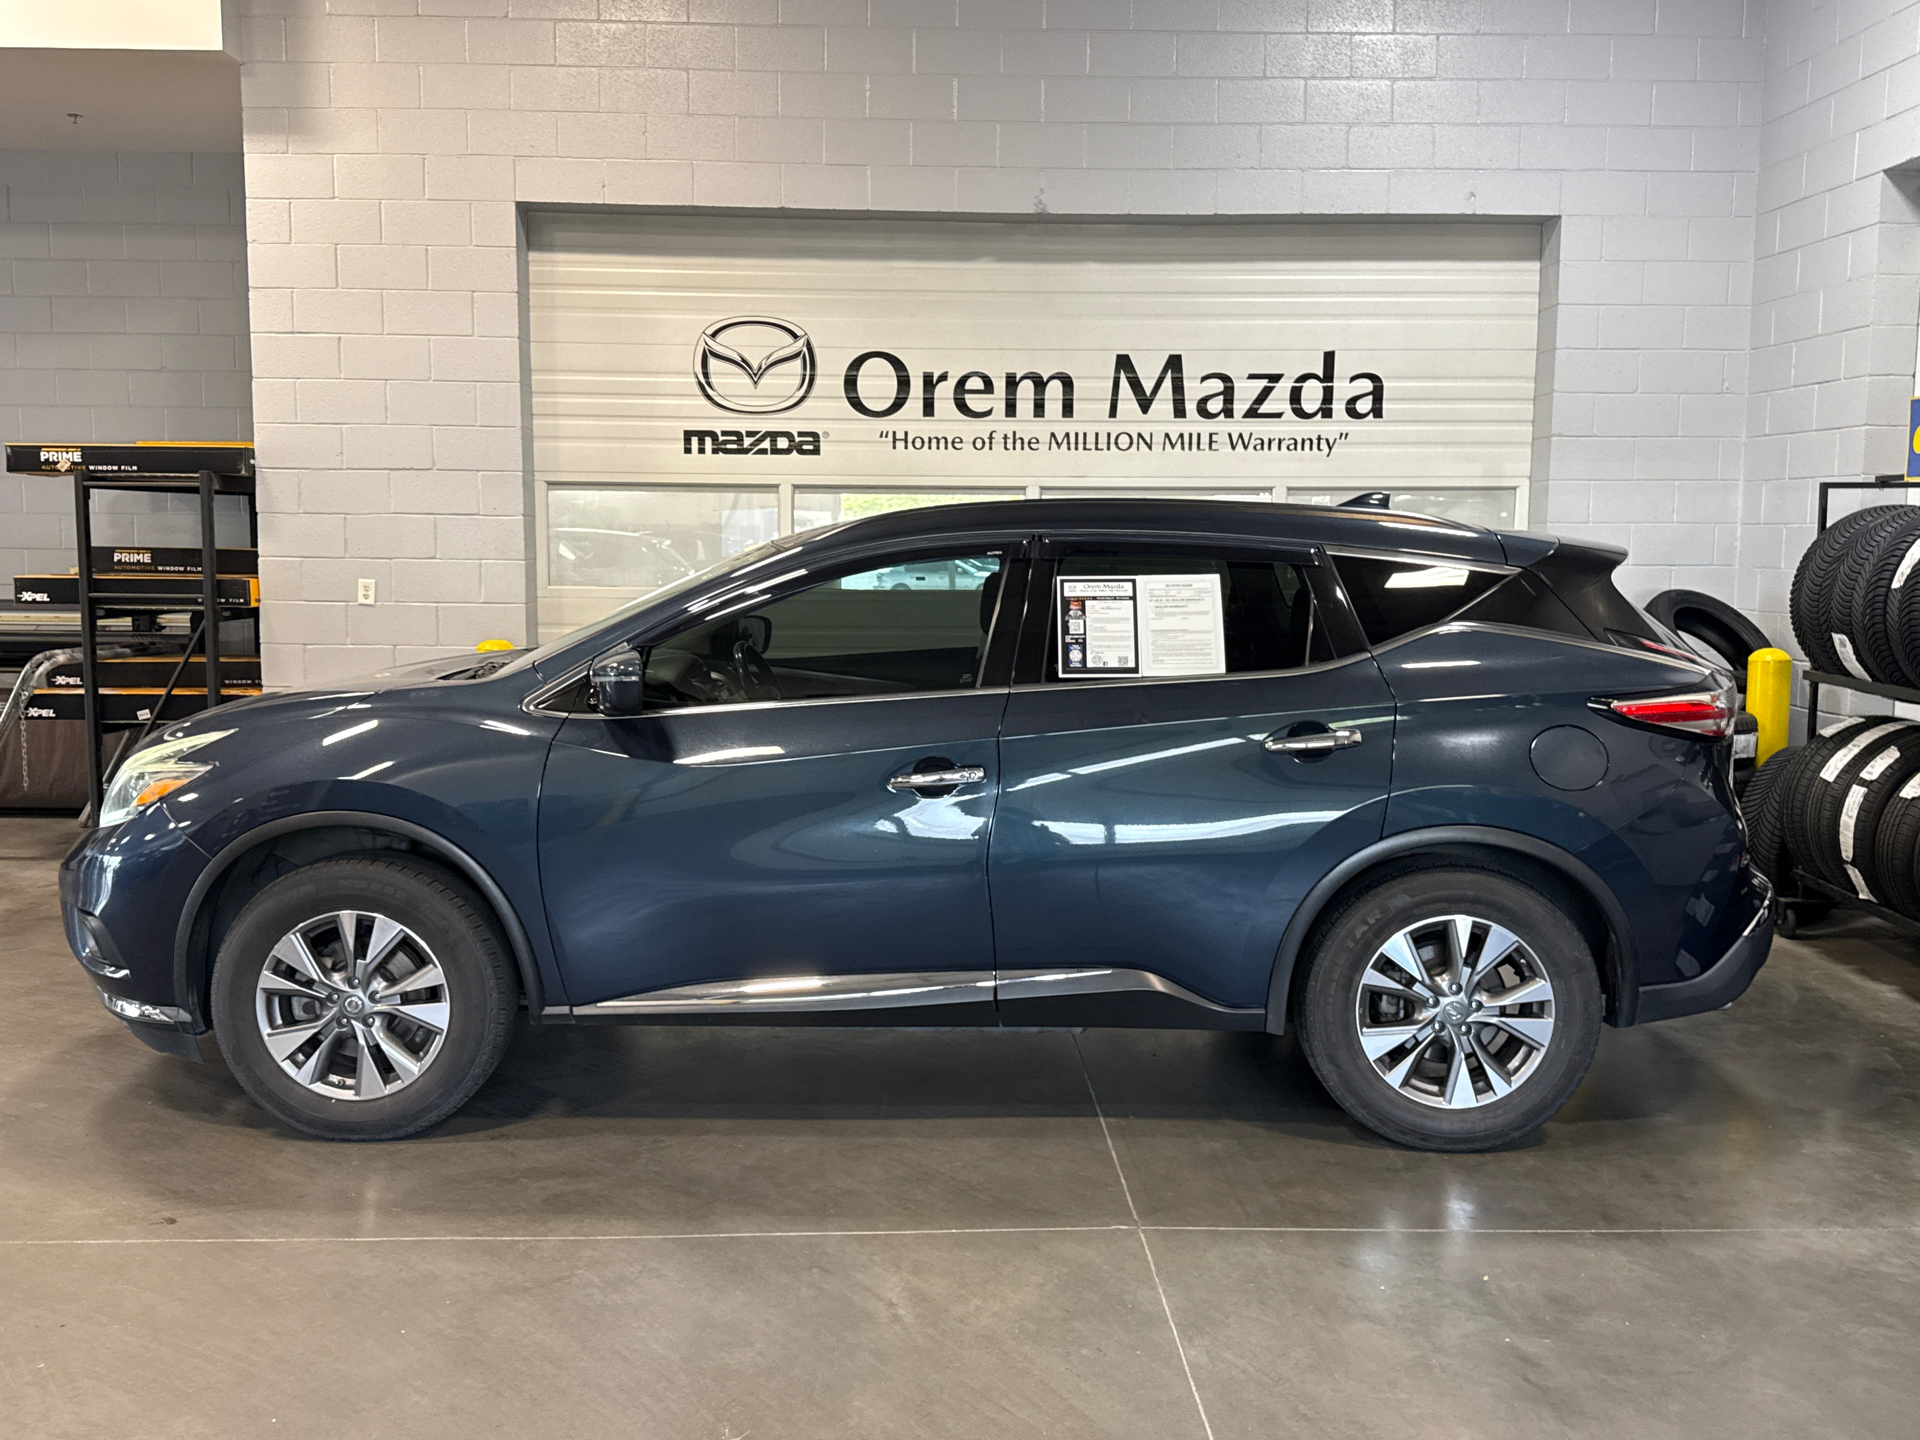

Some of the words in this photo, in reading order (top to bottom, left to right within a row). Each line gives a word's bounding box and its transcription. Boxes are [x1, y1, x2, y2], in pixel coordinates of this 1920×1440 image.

[843, 351, 1075, 419] Orem
[1108, 350, 1385, 420] Mazda
[971, 430, 997, 451] of
[1002, 430, 1040, 451] the
[1048, 431, 1153, 452] MILLION
[1162, 432, 1220, 452] MILE
[40, 452, 82, 462] PRIME
[113, 552, 152, 563] PRIME
